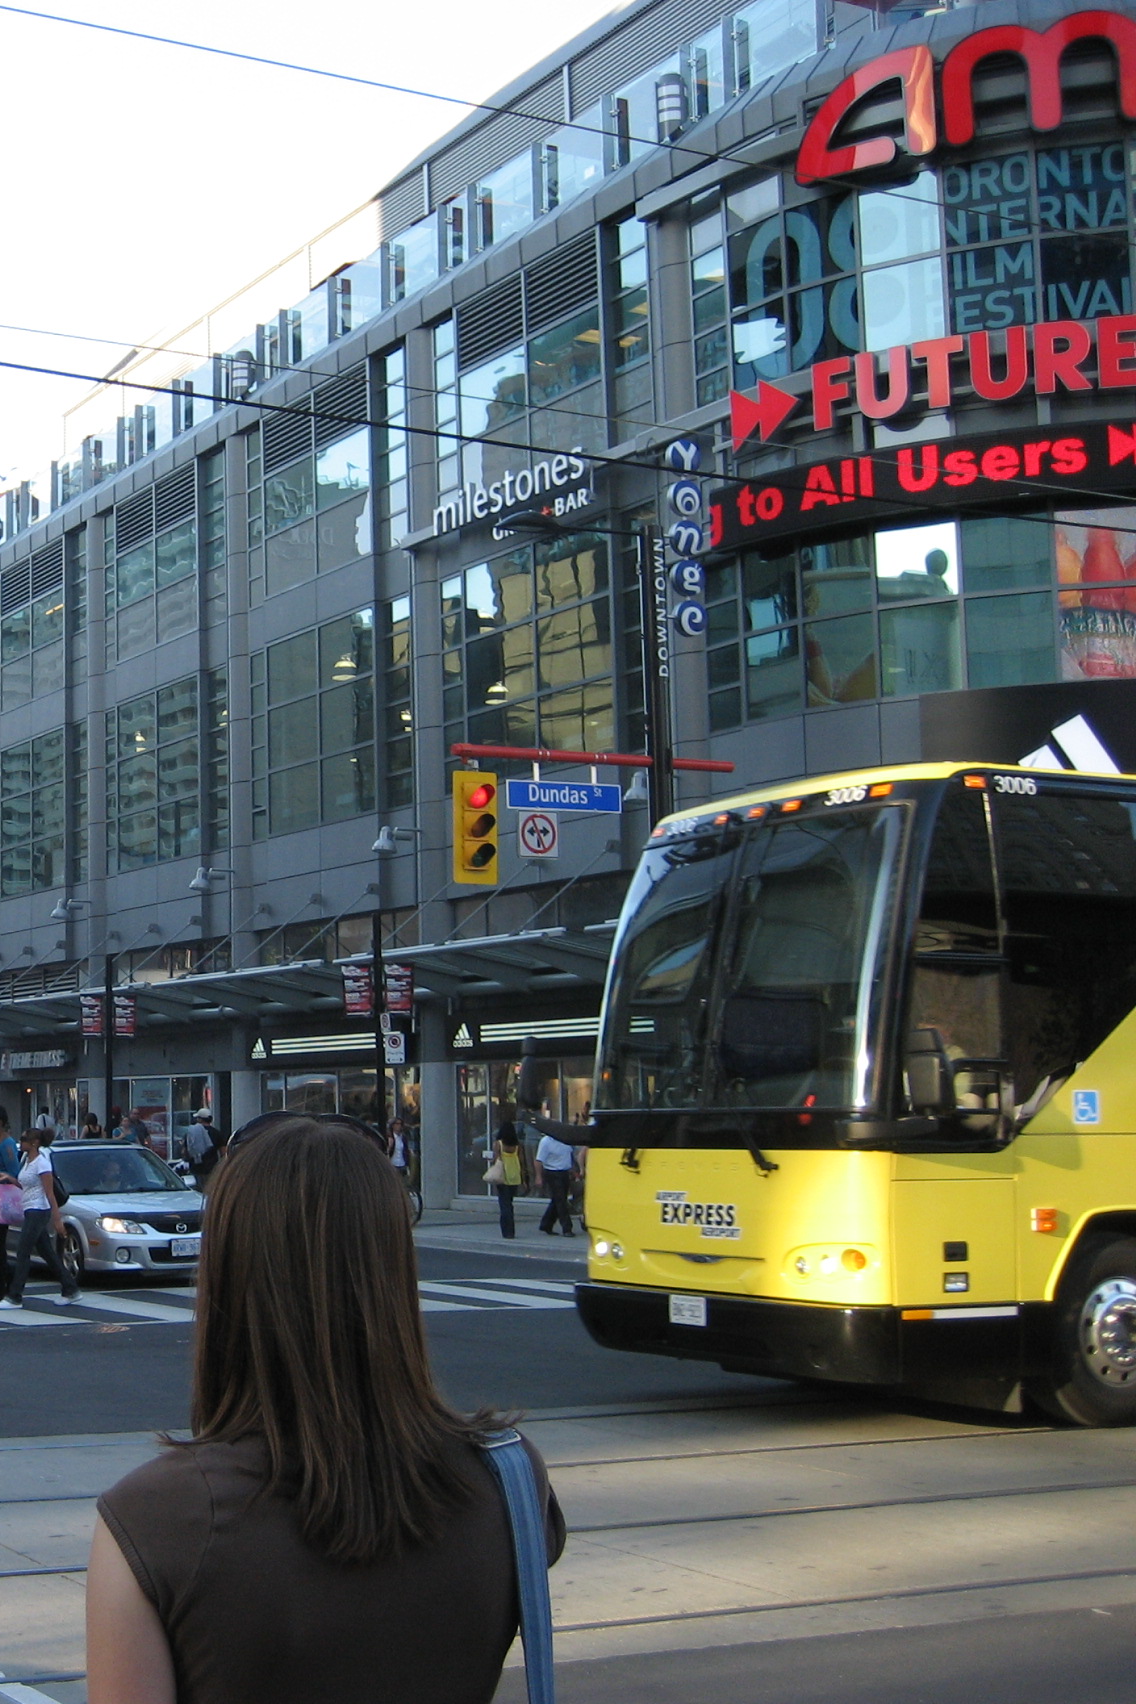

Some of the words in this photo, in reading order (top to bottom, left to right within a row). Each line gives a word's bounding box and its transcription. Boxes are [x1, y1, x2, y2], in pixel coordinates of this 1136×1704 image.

[944, 143, 1124, 205] ORONTO
[811, 315, 1136, 431] FUTURE
[433, 446, 585, 536] milestones
[554, 488, 589, 517] BAR
[736, 484, 784, 526] to
[800, 456, 874, 512] All
[897, 437, 1089, 493] Users
[654, 538, 669, 678] DOWNTOWN
[528, 784, 588, 805] Dundas
[593, 786, 603, 797] St
[824, 785, 867, 806] 3006
[993, 775, 1037, 796] 3006
[661, 1202, 735, 1227] EXPRESS
